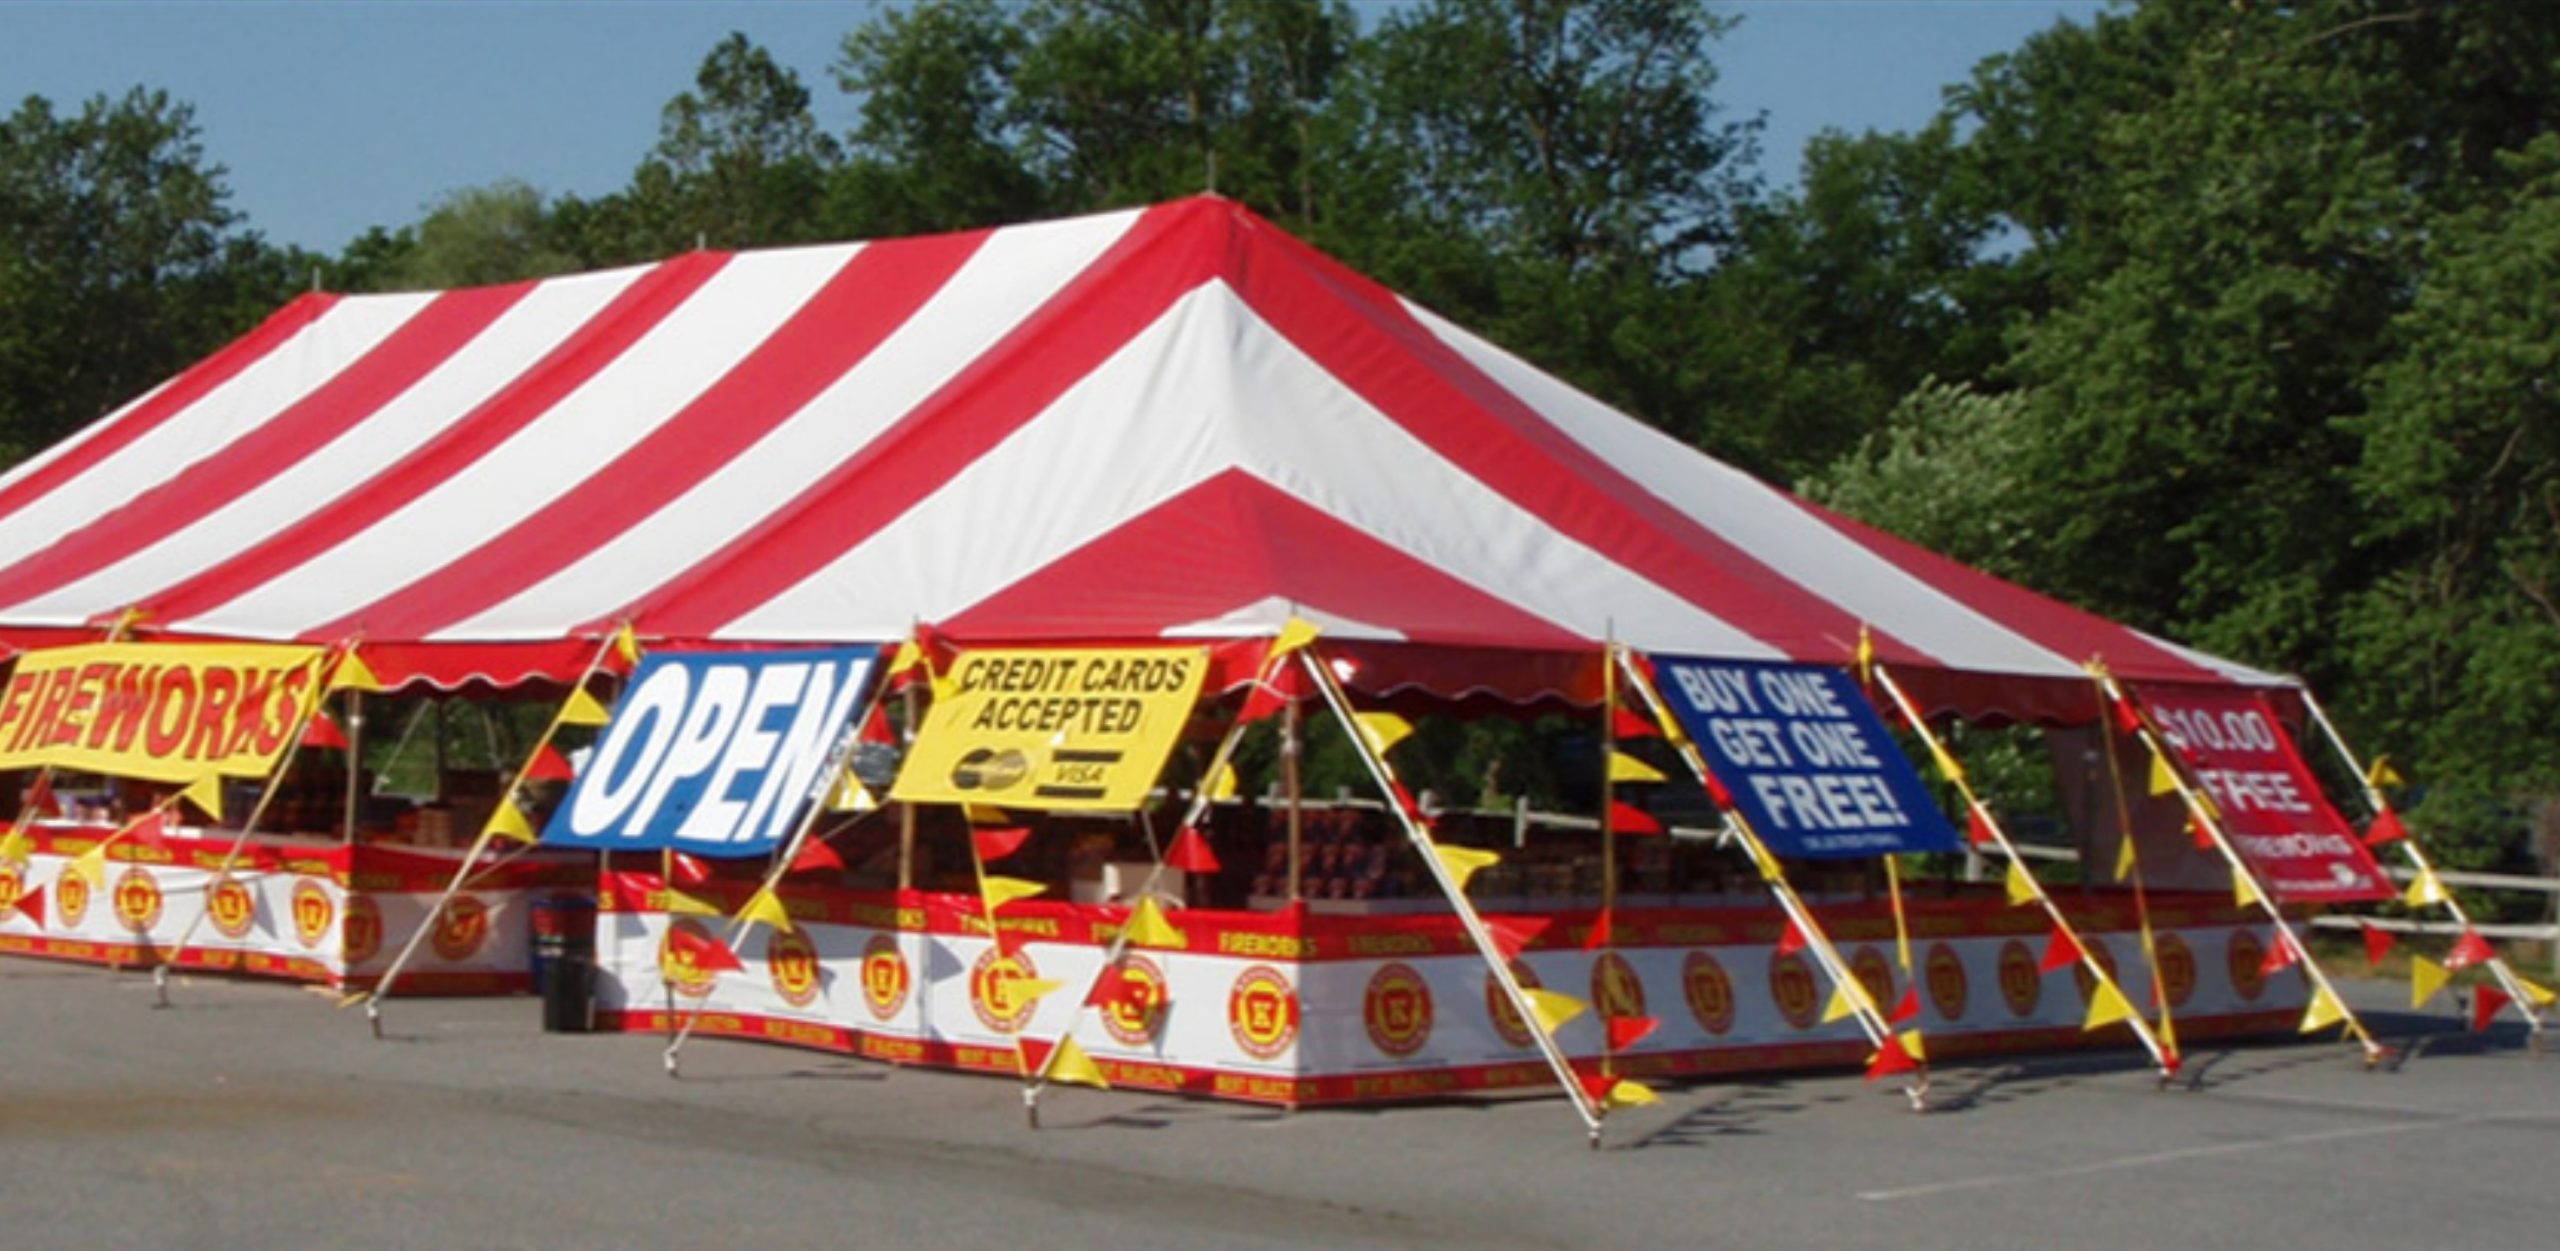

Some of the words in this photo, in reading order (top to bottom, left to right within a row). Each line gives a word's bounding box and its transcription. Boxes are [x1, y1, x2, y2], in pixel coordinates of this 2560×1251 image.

[960, 658, 1078, 692] CREDIT
[1080, 659, 1190, 693] CARDS
[1669, 666, 1763, 715] BUY
[1756, 670, 1850, 717] ONE
[0, 662, 303, 759] FIREWORKS
[971, 699, 1143, 733] ACCEPTED
[2153, 706, 2277, 751] $10.00
[570, 659, 872, 842] OPEN
[1708, 718, 1794, 768] GET
[1788, 722, 1883, 769] ONE
[1053, 764, 1104, 783] VISA
[2196, 769, 2313, 812] FREE
[1748, 774, 1911, 830] FREE!
